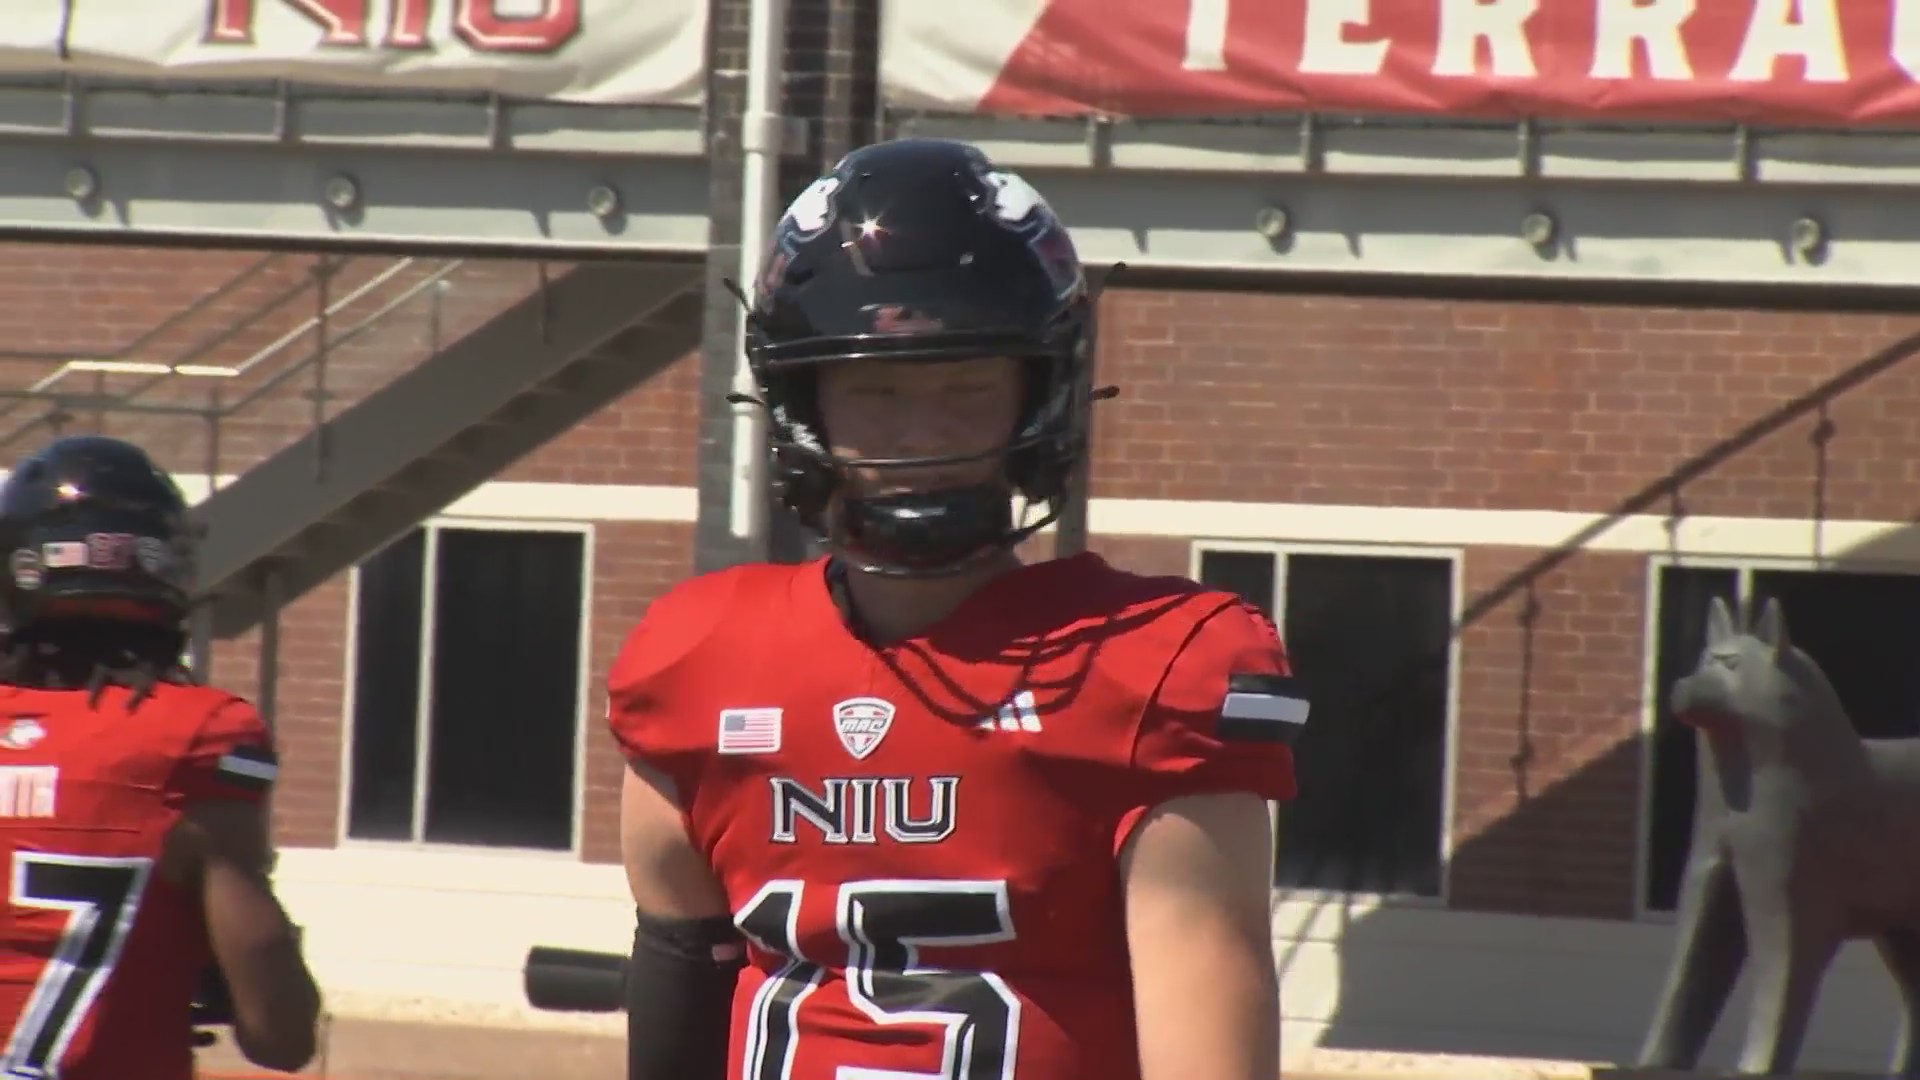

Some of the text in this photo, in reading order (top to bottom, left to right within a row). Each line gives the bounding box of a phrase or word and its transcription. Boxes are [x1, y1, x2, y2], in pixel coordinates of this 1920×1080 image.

[1181, 0, 1920, 84] ERRA
[769, 776, 963, 844] NIU
[734, 878, 1022, 1080] 15
